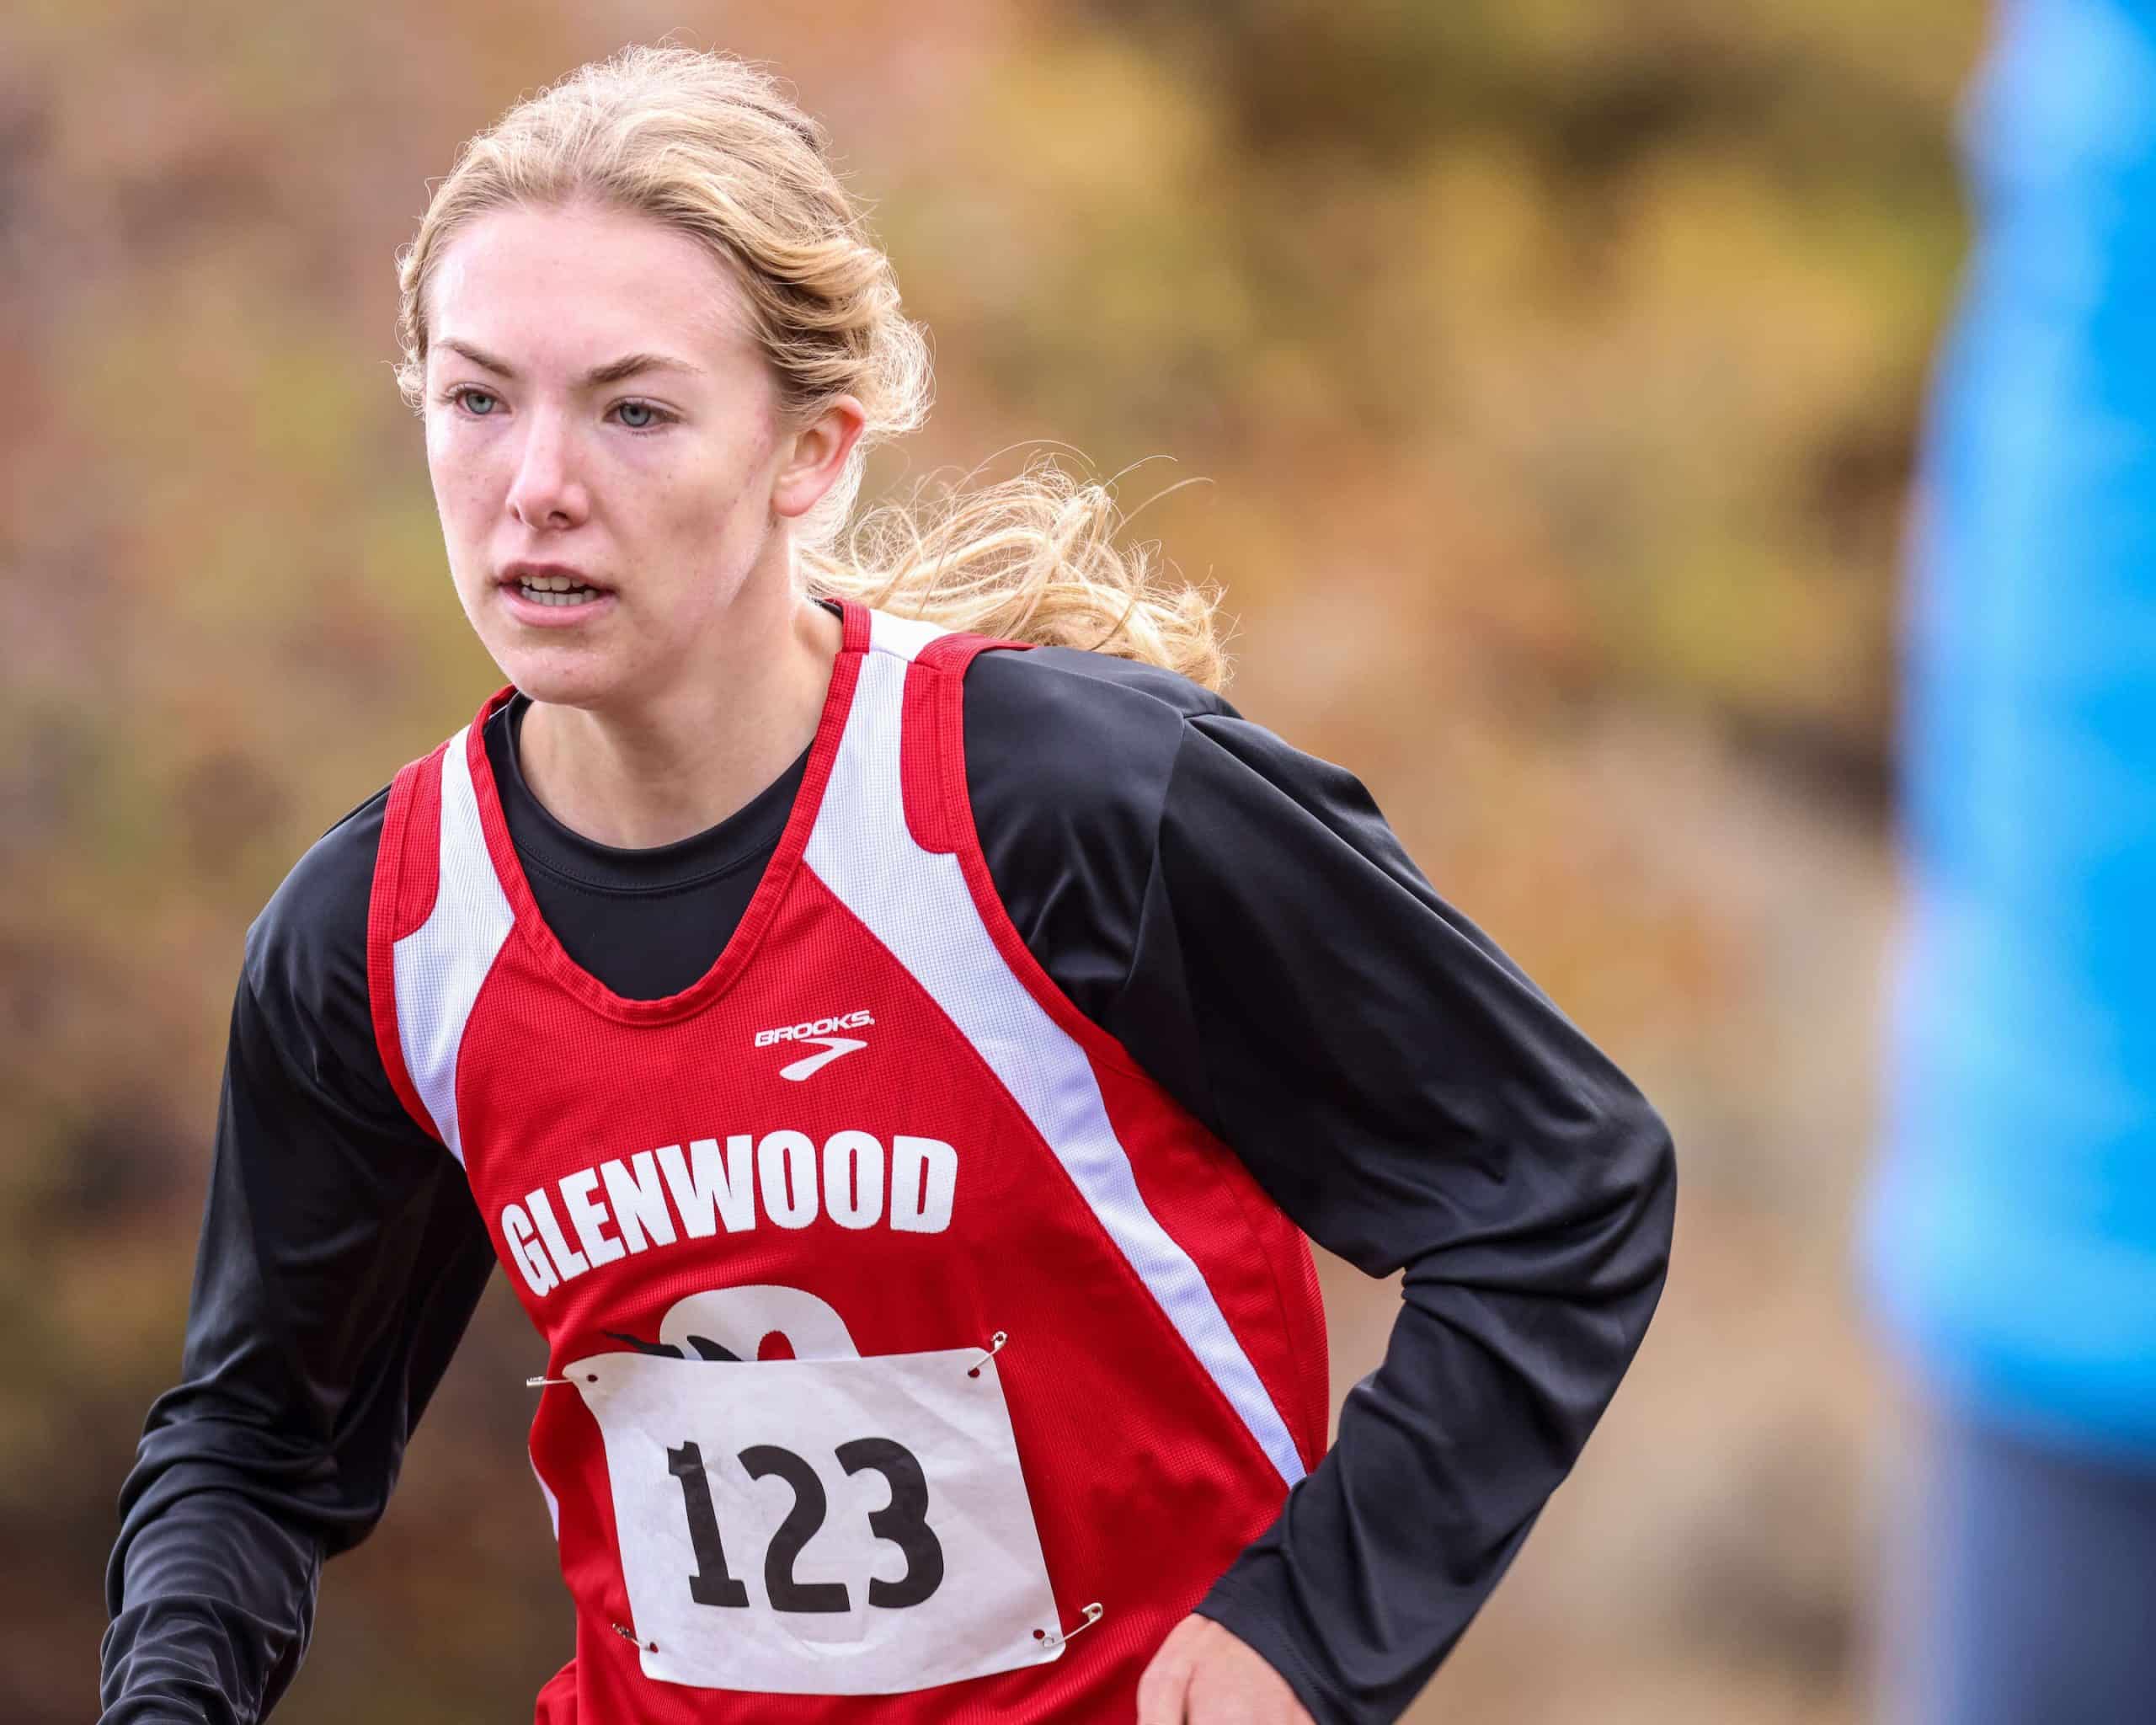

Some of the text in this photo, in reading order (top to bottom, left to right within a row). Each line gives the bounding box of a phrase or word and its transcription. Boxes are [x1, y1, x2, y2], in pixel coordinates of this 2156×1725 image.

[755, 1010, 871, 1047] BROOKS
[501, 1130, 958, 1297] GLENWOOD
[666, 1437, 945, 1614] 123
